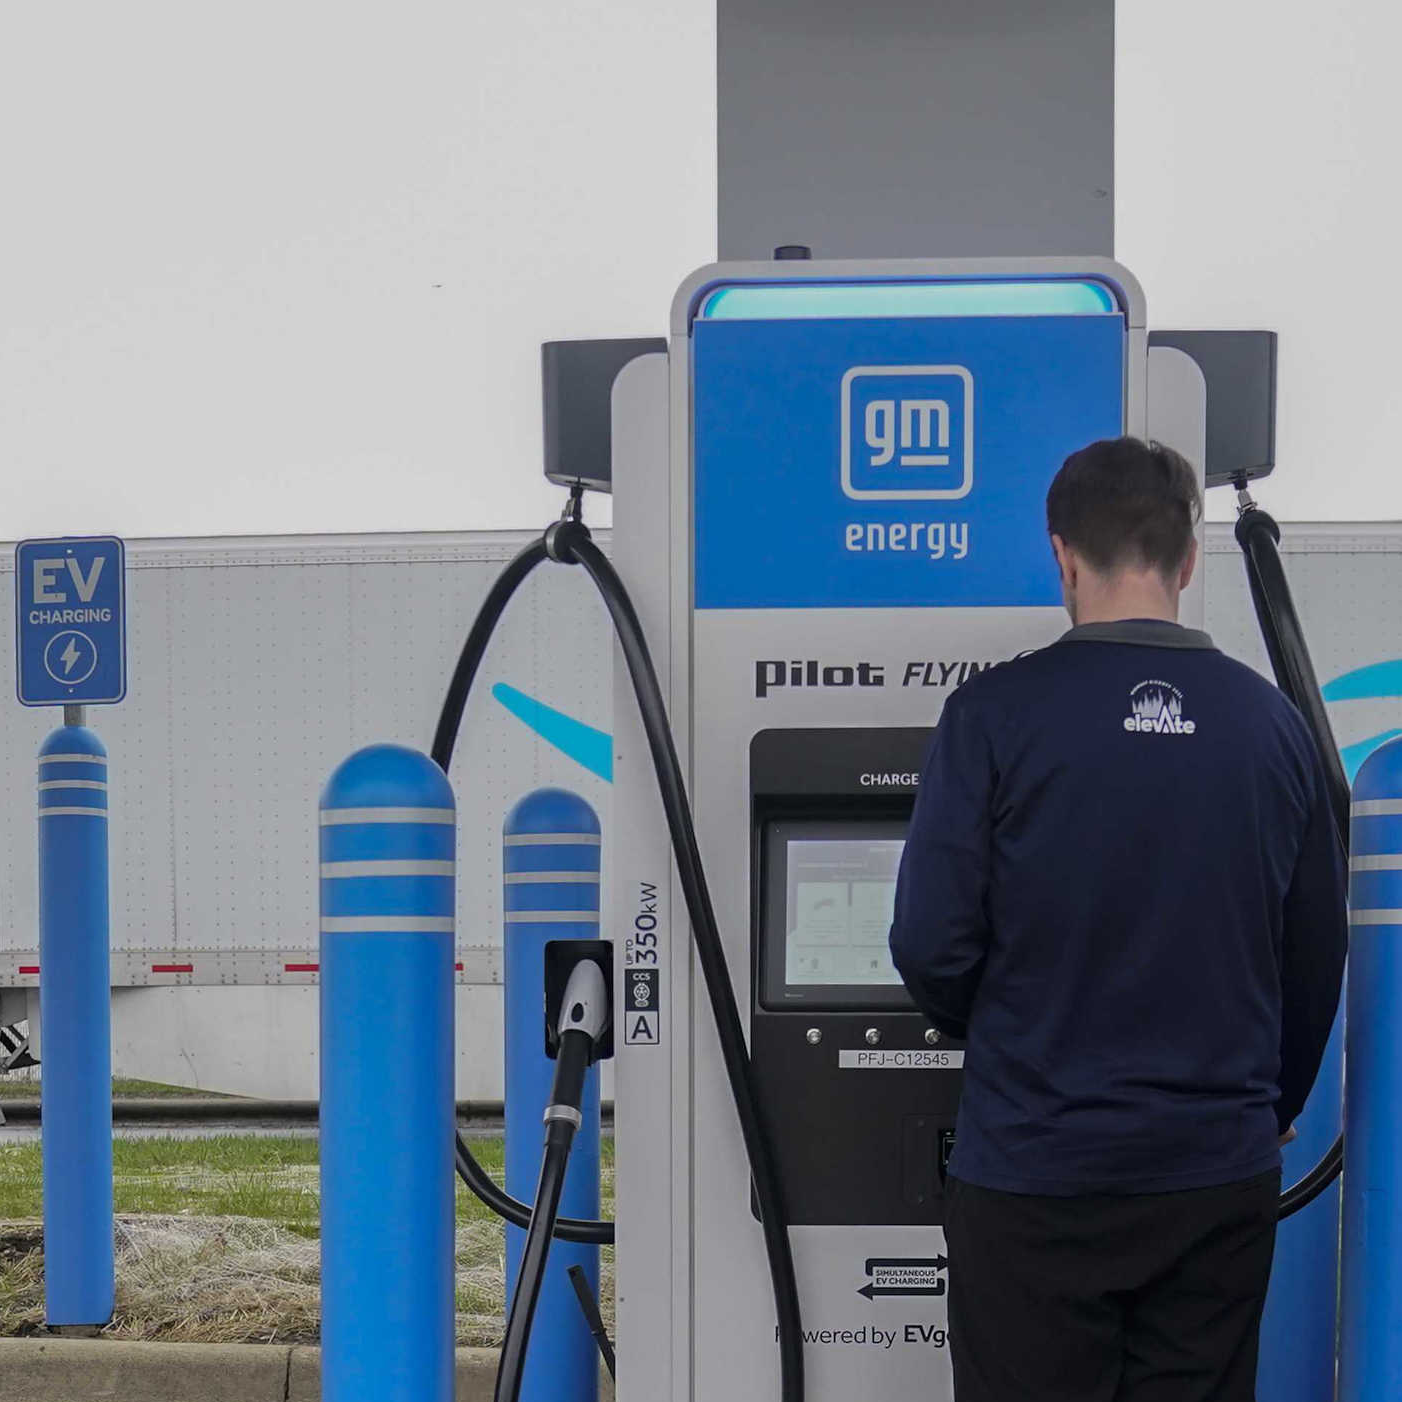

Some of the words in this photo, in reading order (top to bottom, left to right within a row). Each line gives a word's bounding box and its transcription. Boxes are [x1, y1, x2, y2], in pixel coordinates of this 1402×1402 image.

[865, 400, 950, 467] gm
[845, 522, 968, 560] energy
[33, 556, 106, 604] EV
[29, 608, 112, 625] CHARGING
[859, 773, 920, 786] CHARGE
[632, 972, 651, 981] CCS
[631, 1015, 653, 1040] A
[857, 1052, 950, 1066] PFJ-C12545
[875, 1269, 936, 1277] SIMULTANEOUS
[875, 1277, 887, 1285] EV
[888, 1277, 936, 1285] CHARGING
[775, 1326, 867, 1344] wered
[871, 1326, 897, 1349] by
[903, 1324, 950, 1348] EVg
